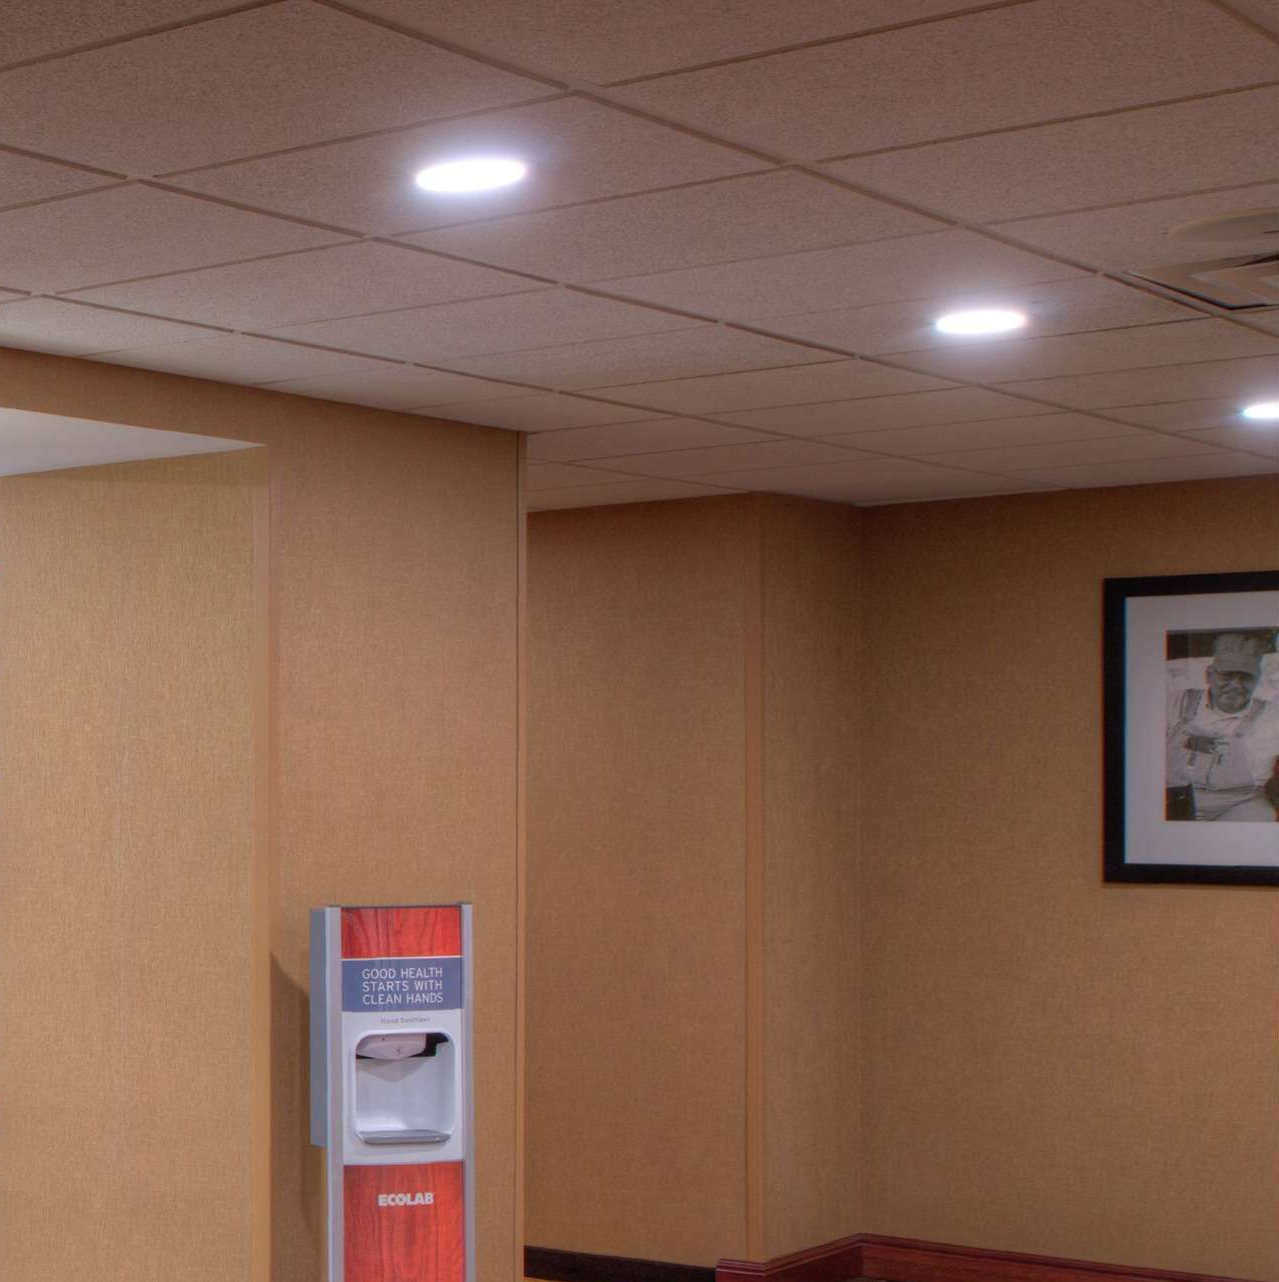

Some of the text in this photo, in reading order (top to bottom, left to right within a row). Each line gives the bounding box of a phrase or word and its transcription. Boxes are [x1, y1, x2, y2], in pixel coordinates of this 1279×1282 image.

[362, 967, 443, 980] GOOD HEALTH
[362, 980, 443, 992] STARTS WITH
[363, 992, 444, 1005] CLEAN HANDS
[378, 1192, 435, 1207] ECOLAB
